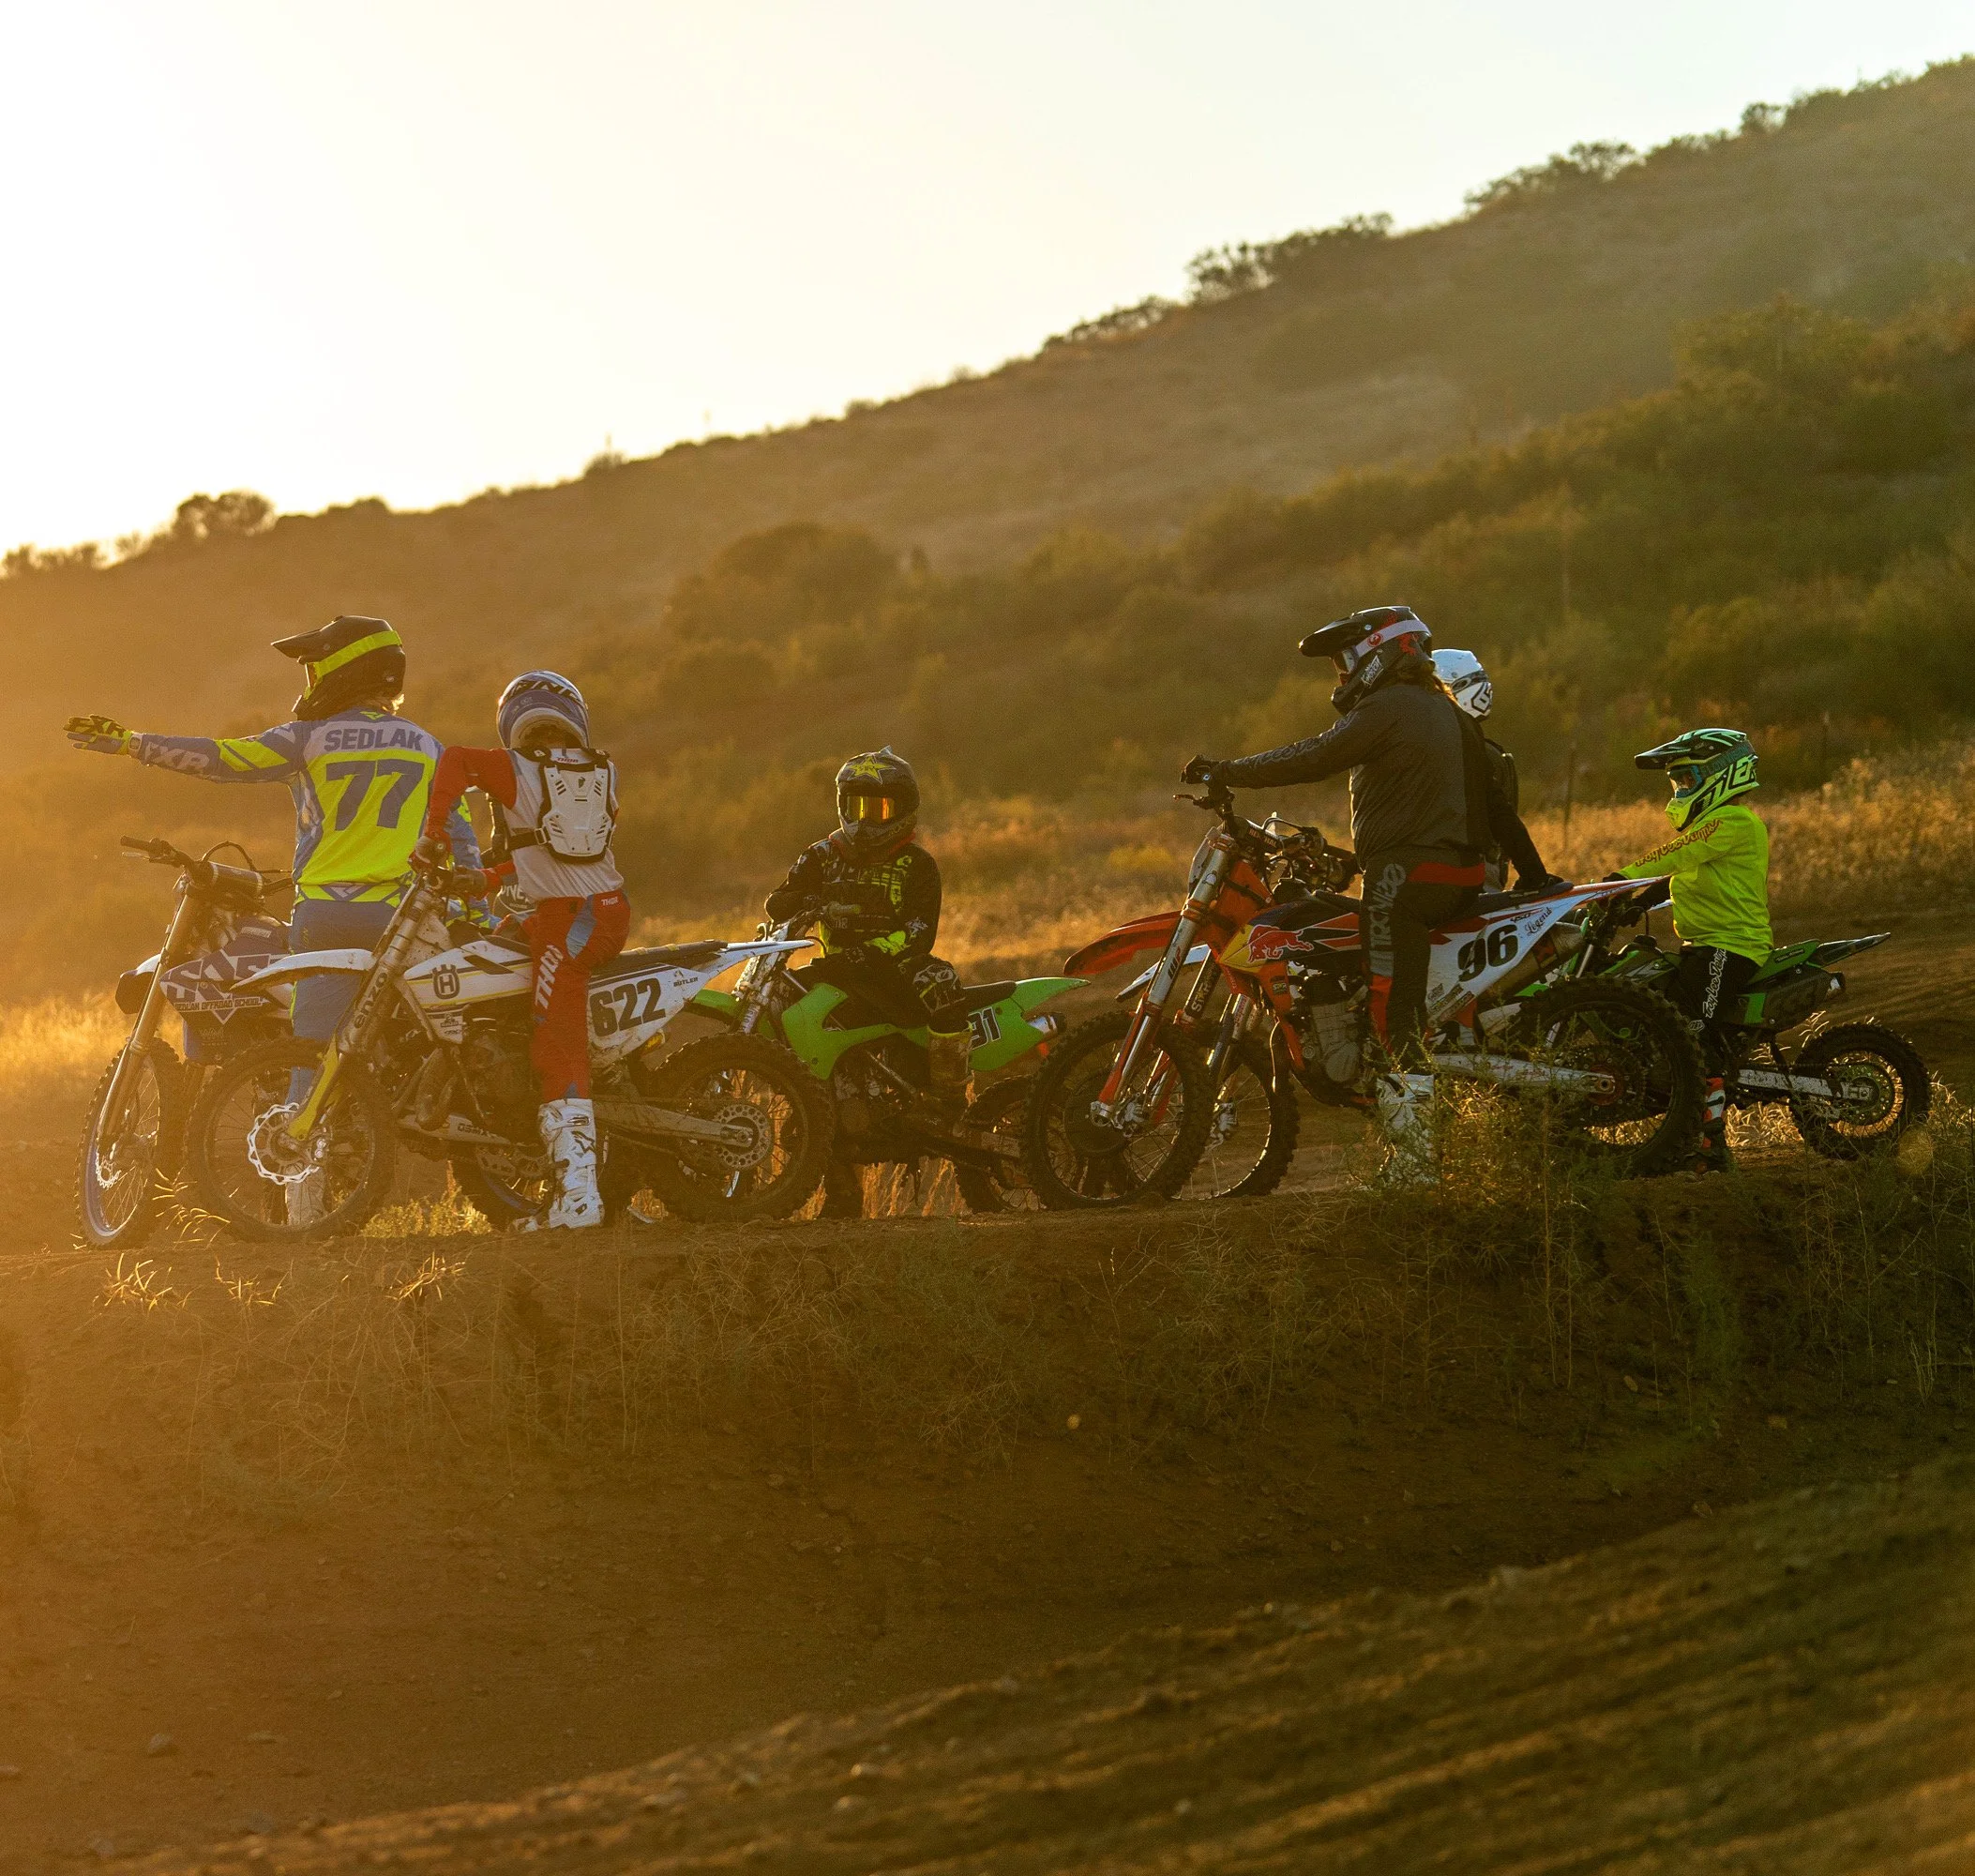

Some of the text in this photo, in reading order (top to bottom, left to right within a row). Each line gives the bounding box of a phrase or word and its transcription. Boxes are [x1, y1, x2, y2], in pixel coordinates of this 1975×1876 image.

[324, 728, 423, 751] SEDLAK
[325, 758, 426, 831] 77
[601, 896, 619, 906] THOR
[1524, 906, 1553, 936] Legend
[1457, 924, 1519, 982] 96
[535, 945, 564, 1010] THOR
[673, 976, 699, 988] BUTLER
[1705, 976, 1721, 997] Lee
[202, 999, 233, 1010] OFFROAD
[234, 997, 262, 1007] SCHOOL
[589, 977, 667, 1037] 622
[1703, 994, 1718, 1019] Troy
